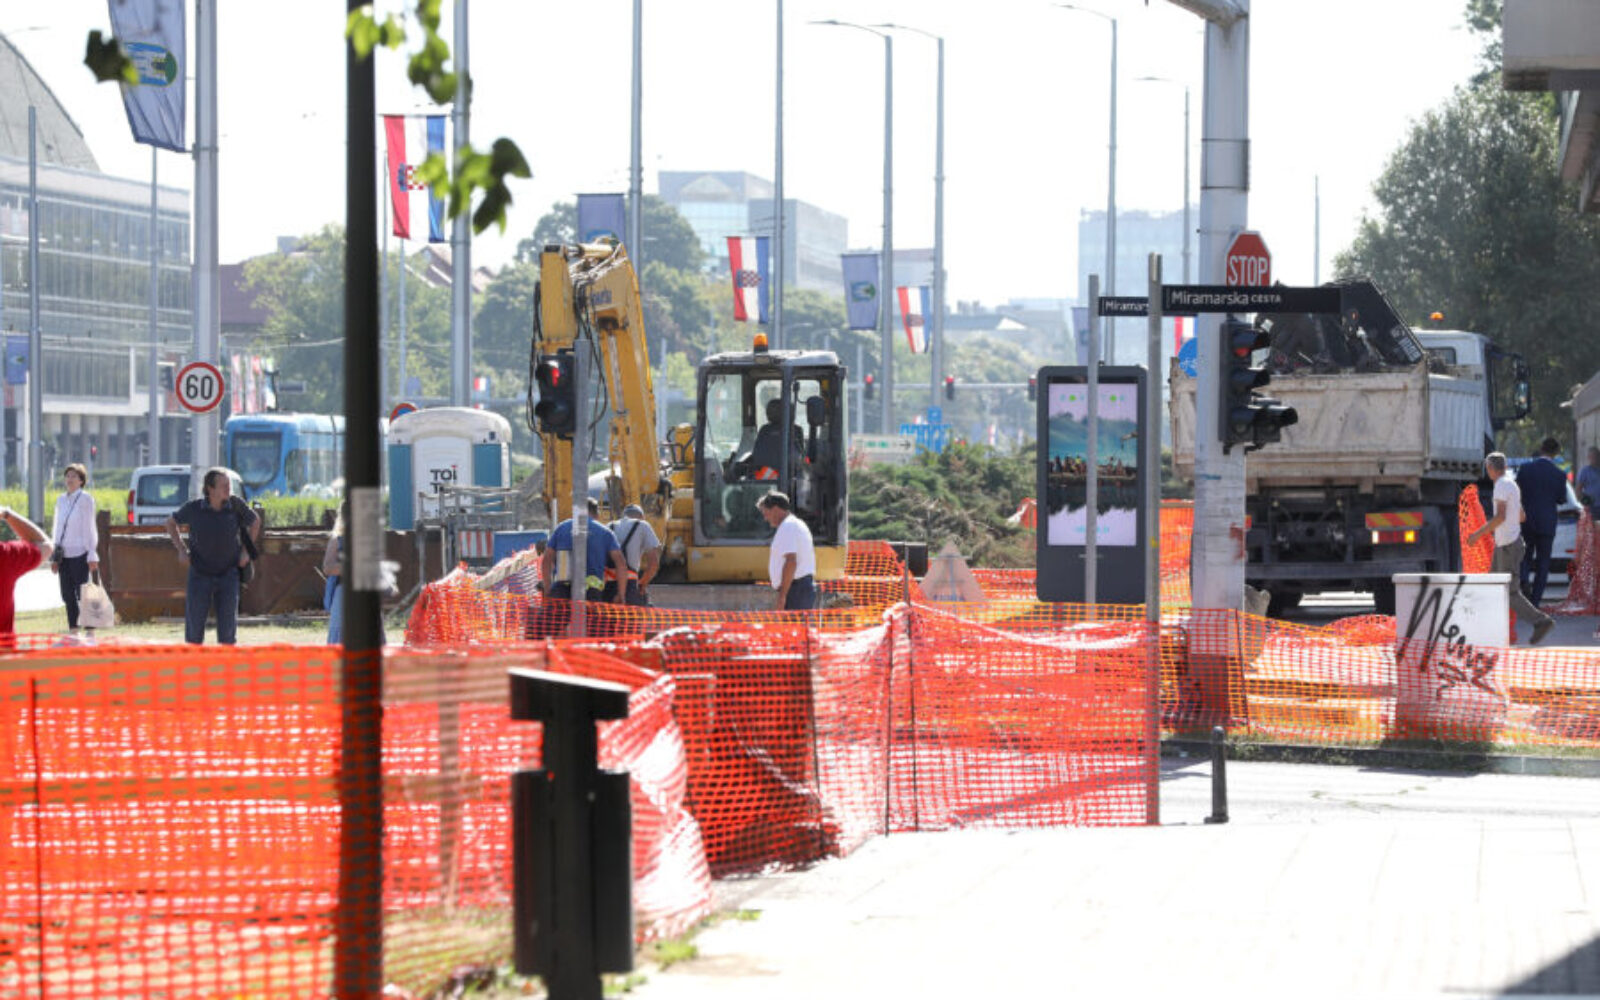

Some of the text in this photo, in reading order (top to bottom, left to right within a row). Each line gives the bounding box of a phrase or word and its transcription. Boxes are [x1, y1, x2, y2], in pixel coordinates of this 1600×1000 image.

[1228, 255, 1268, 286] STOP
[1171, 290, 1281, 305] Miramarska CESTA
[186, 374, 213, 400] 60
